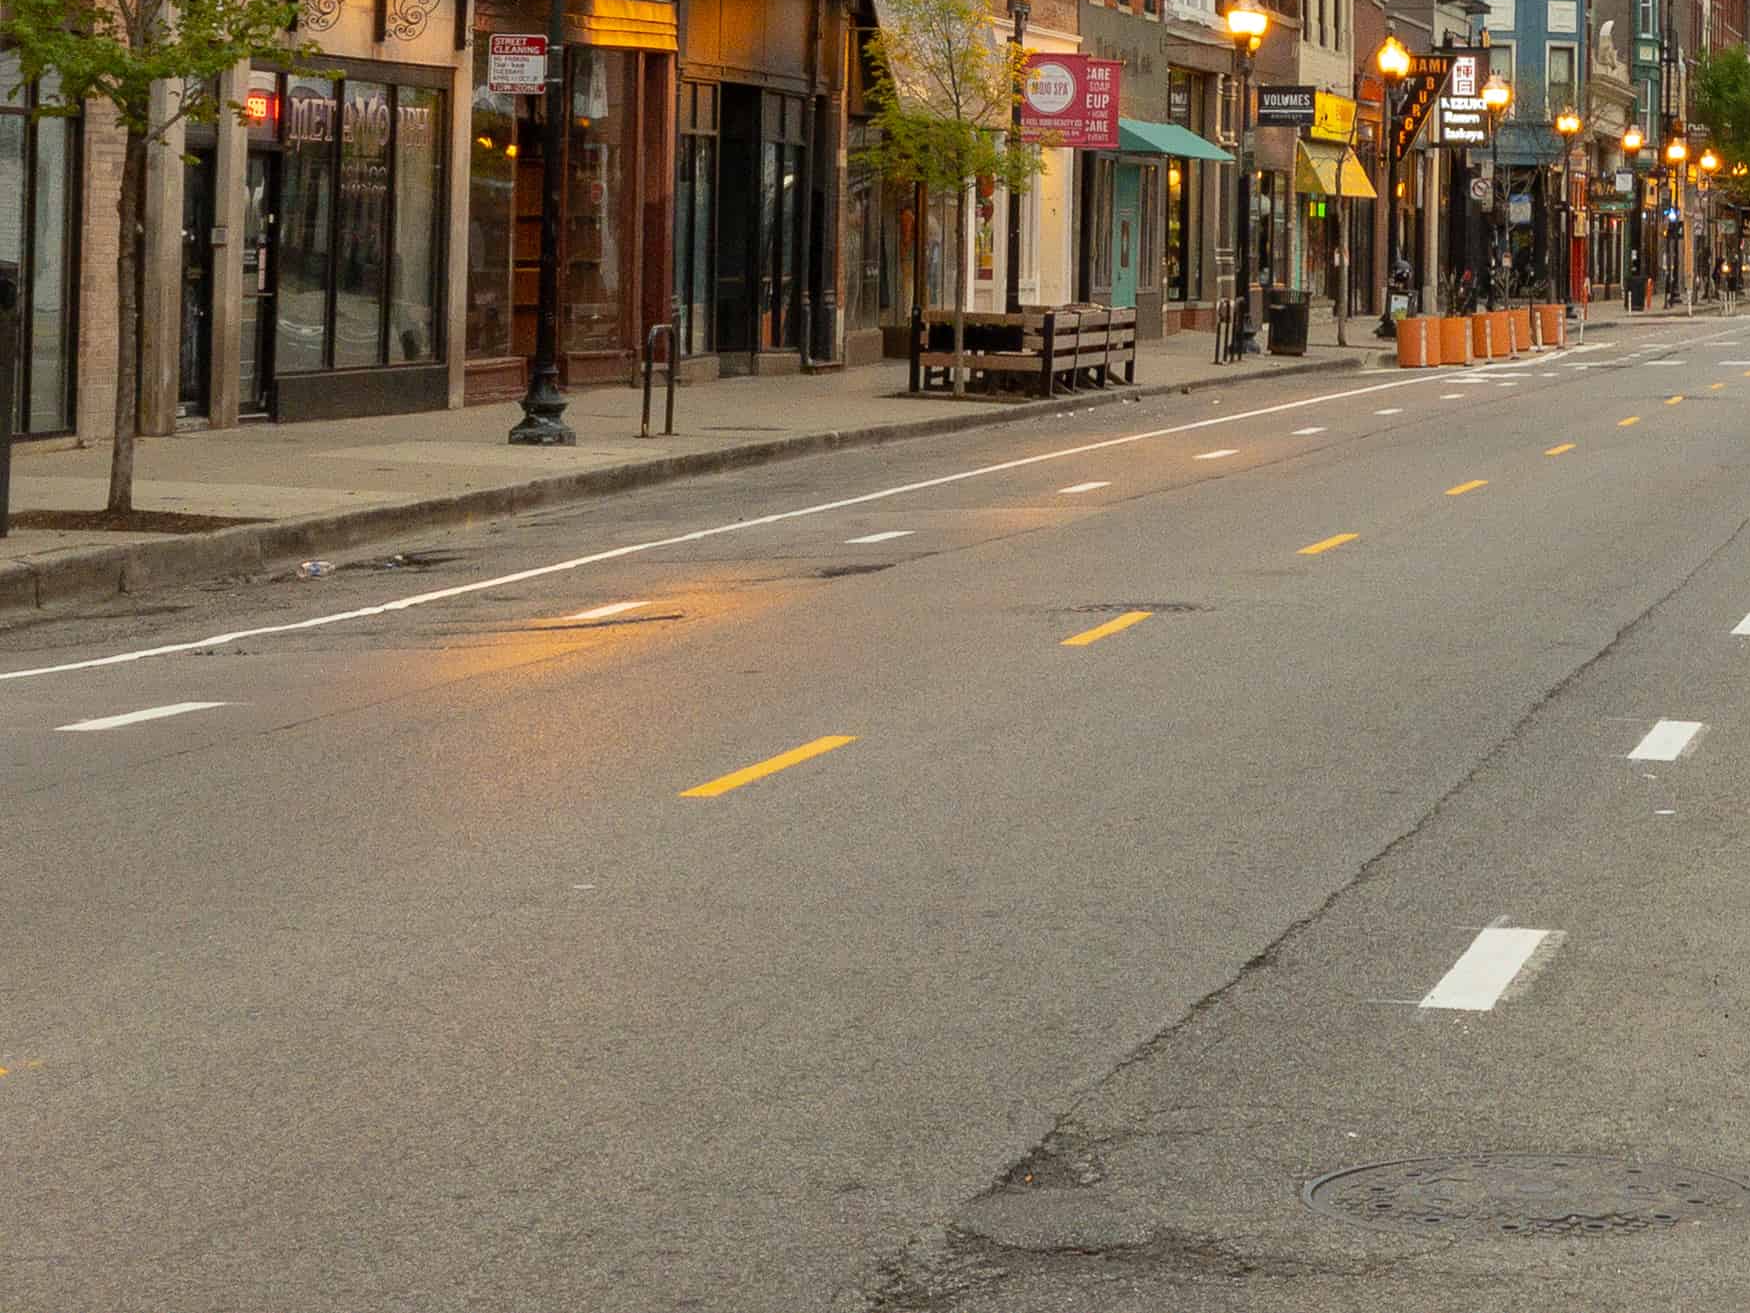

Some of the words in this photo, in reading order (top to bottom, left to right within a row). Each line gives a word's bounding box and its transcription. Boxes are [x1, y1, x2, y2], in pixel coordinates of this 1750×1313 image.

[494, 45, 541, 54] CLEANING
[1263, 93, 1311, 106] VOLUMES
[289, 89, 430, 152] METAMOPH
